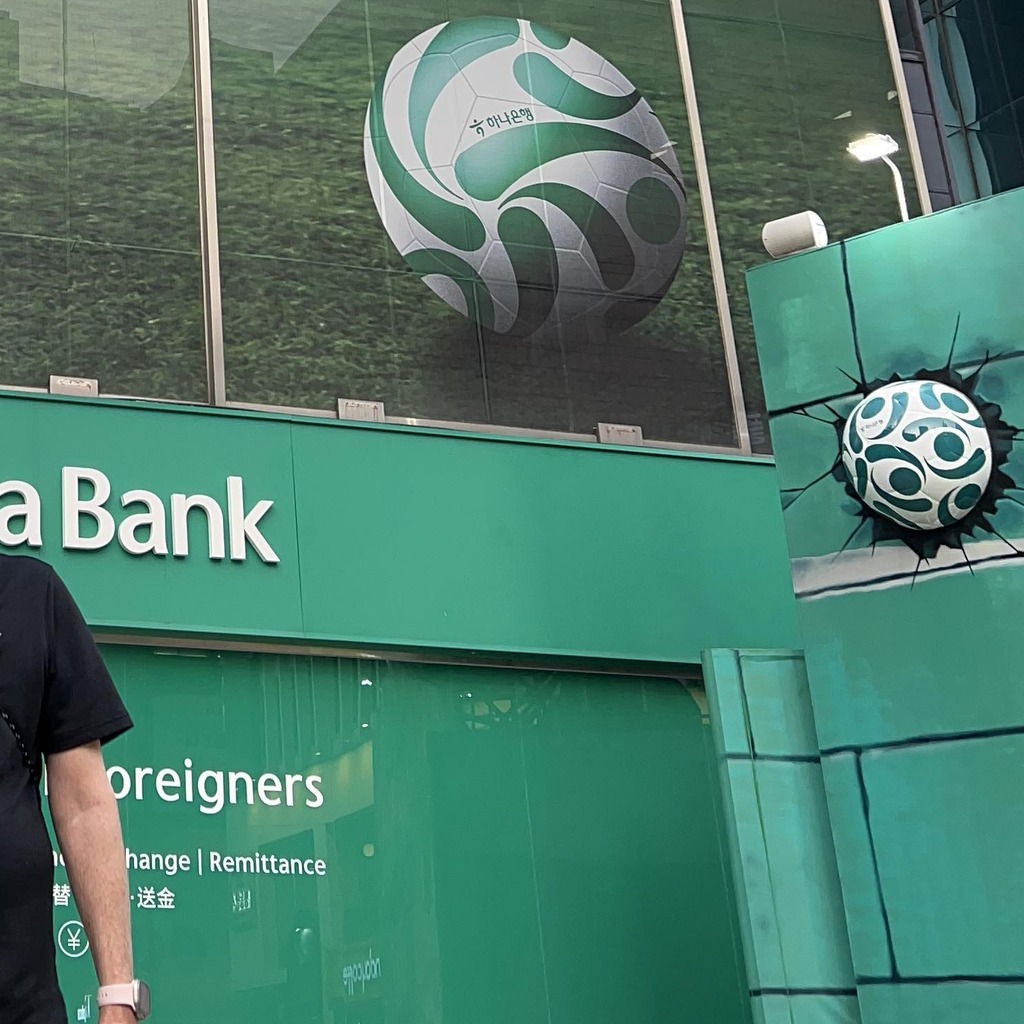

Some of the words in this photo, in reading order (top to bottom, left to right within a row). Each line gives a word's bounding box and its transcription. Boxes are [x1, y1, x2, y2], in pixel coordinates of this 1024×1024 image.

[486, 107, 535, 129] 하나은행
[61, 466, 282, 564] Bank
[107, 759, 325, 815] oreigners
[126, 848, 191, 878] hange
[209, 851, 327, 876] Remittance
